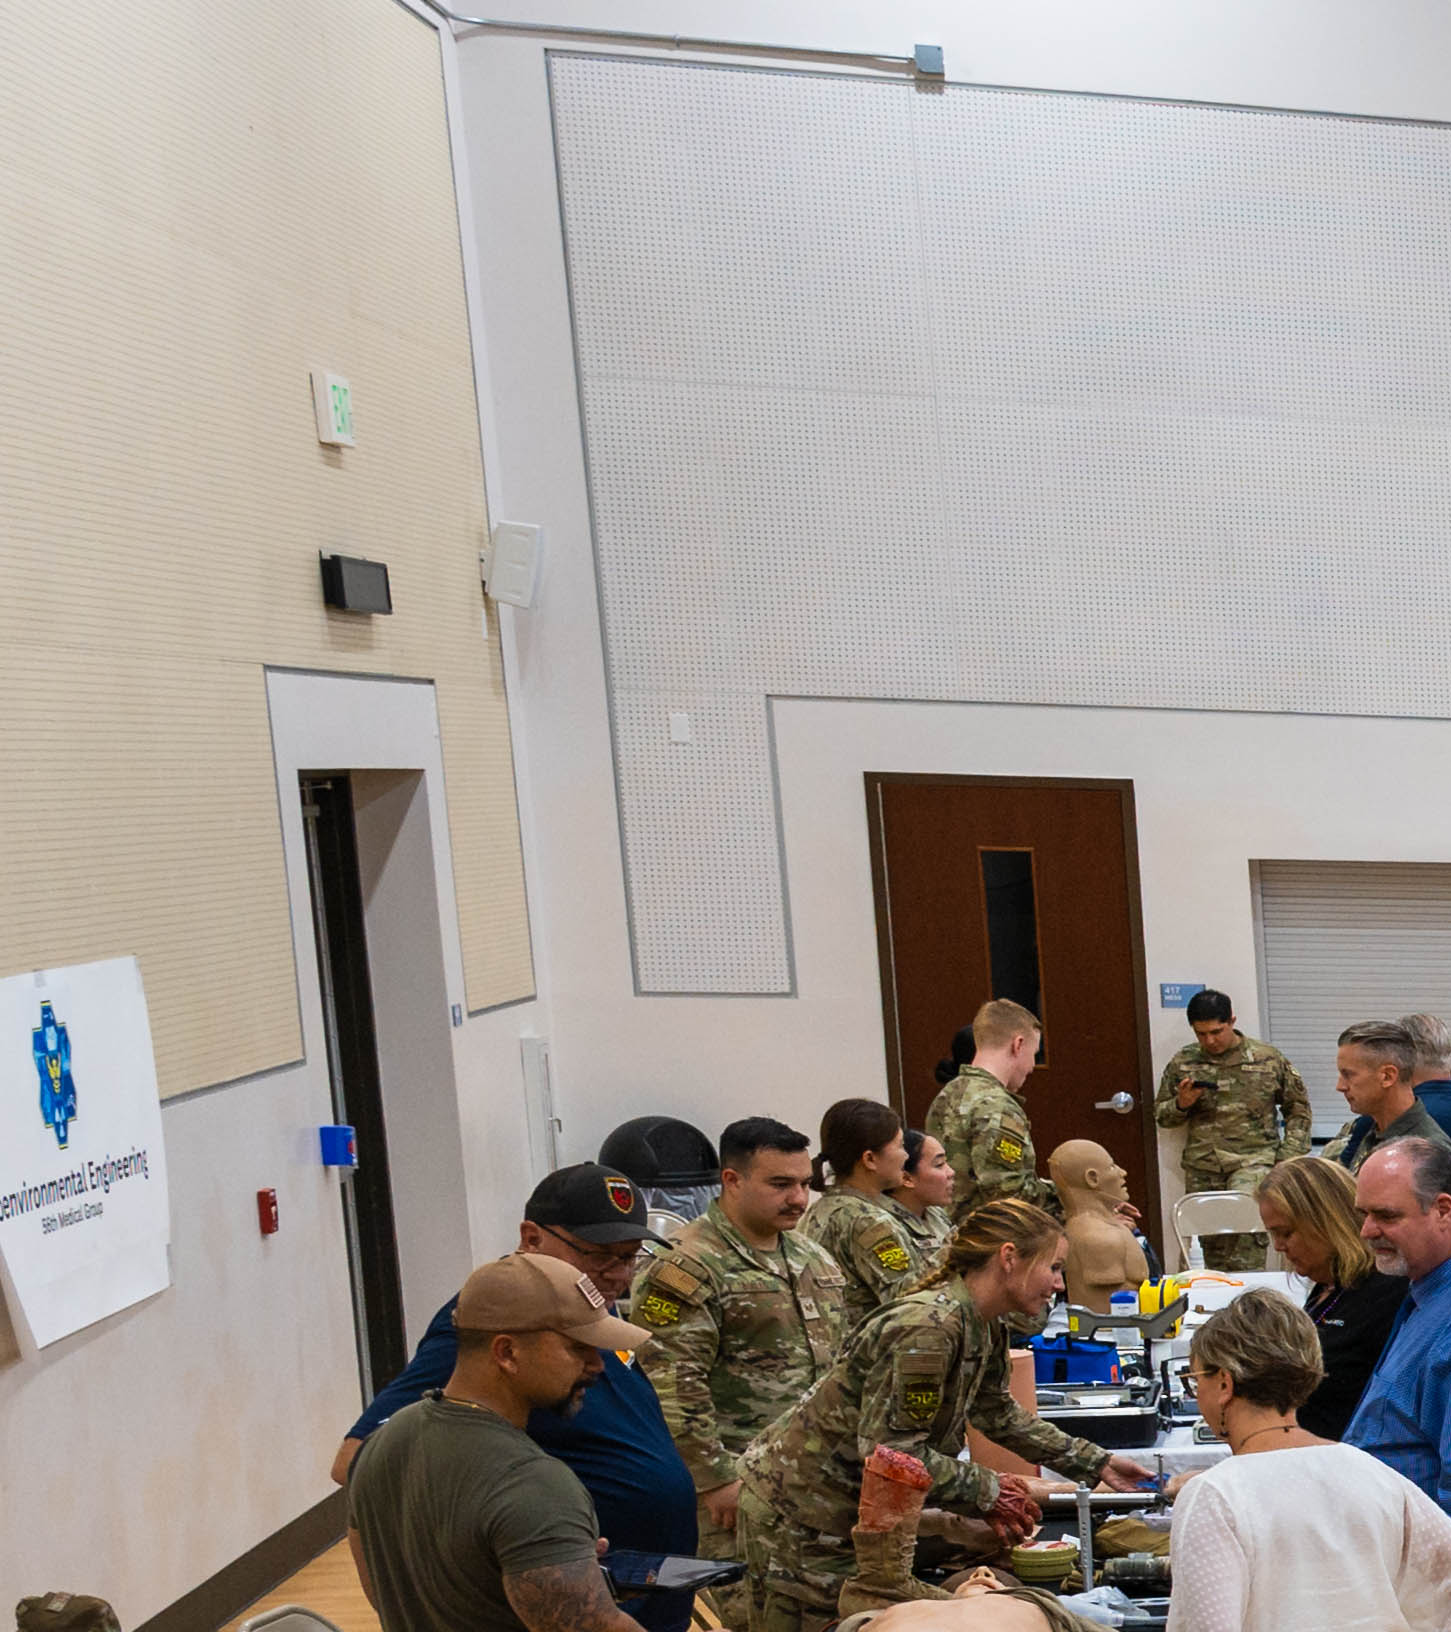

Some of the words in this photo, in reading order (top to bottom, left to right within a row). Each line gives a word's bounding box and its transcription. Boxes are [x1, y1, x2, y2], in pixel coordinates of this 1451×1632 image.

[0, 1162, 89, 1222] environmental
[87, 1146, 149, 1194] Engineering
[58, 1205, 83, 1229] Medical
[84, 1202, 104, 1221] Group
